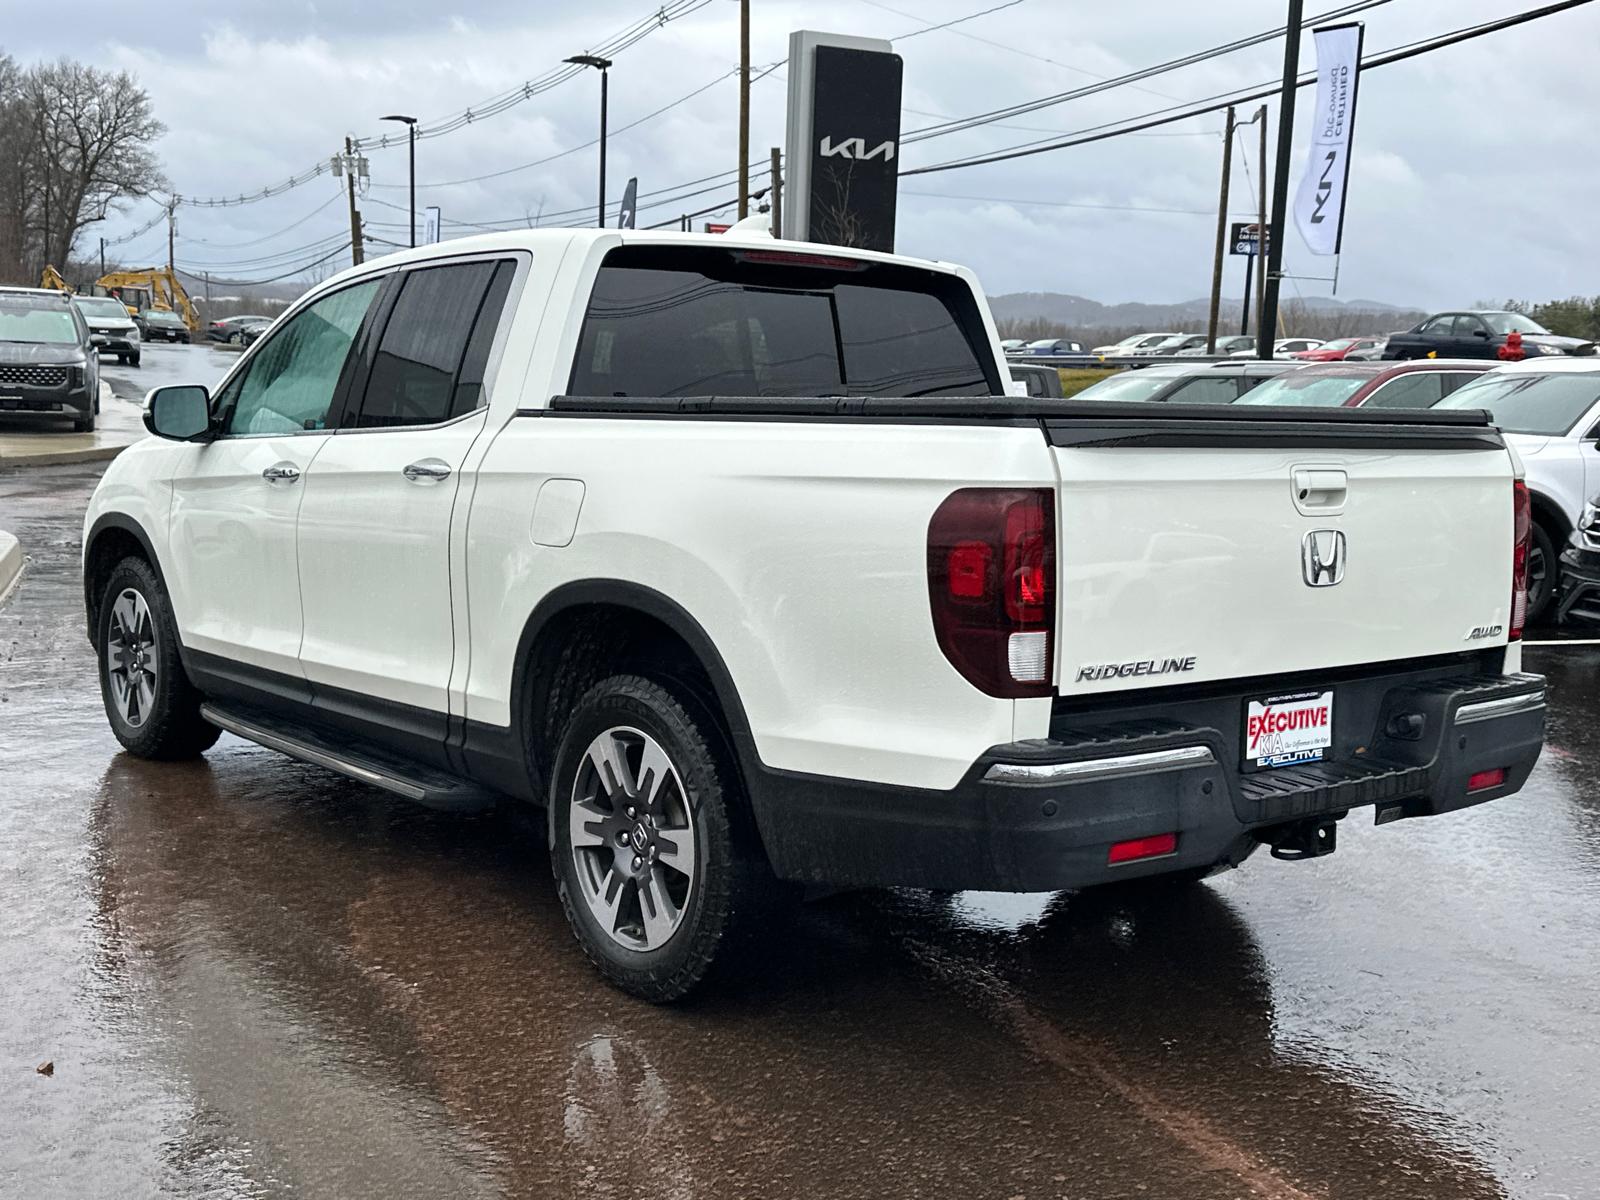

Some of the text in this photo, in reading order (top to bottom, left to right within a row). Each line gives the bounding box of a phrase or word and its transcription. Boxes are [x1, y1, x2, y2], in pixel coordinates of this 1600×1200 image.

[820, 135, 895, 162] KIA
[1464, 625, 1502, 641] AWD
[1075, 656, 1196, 683] RIDGELINE
[1249, 707, 1328, 749] EXECUTIVE
[1260, 733, 1284, 756] KIA
[1257, 749, 1323, 767] EXECUTIVE
